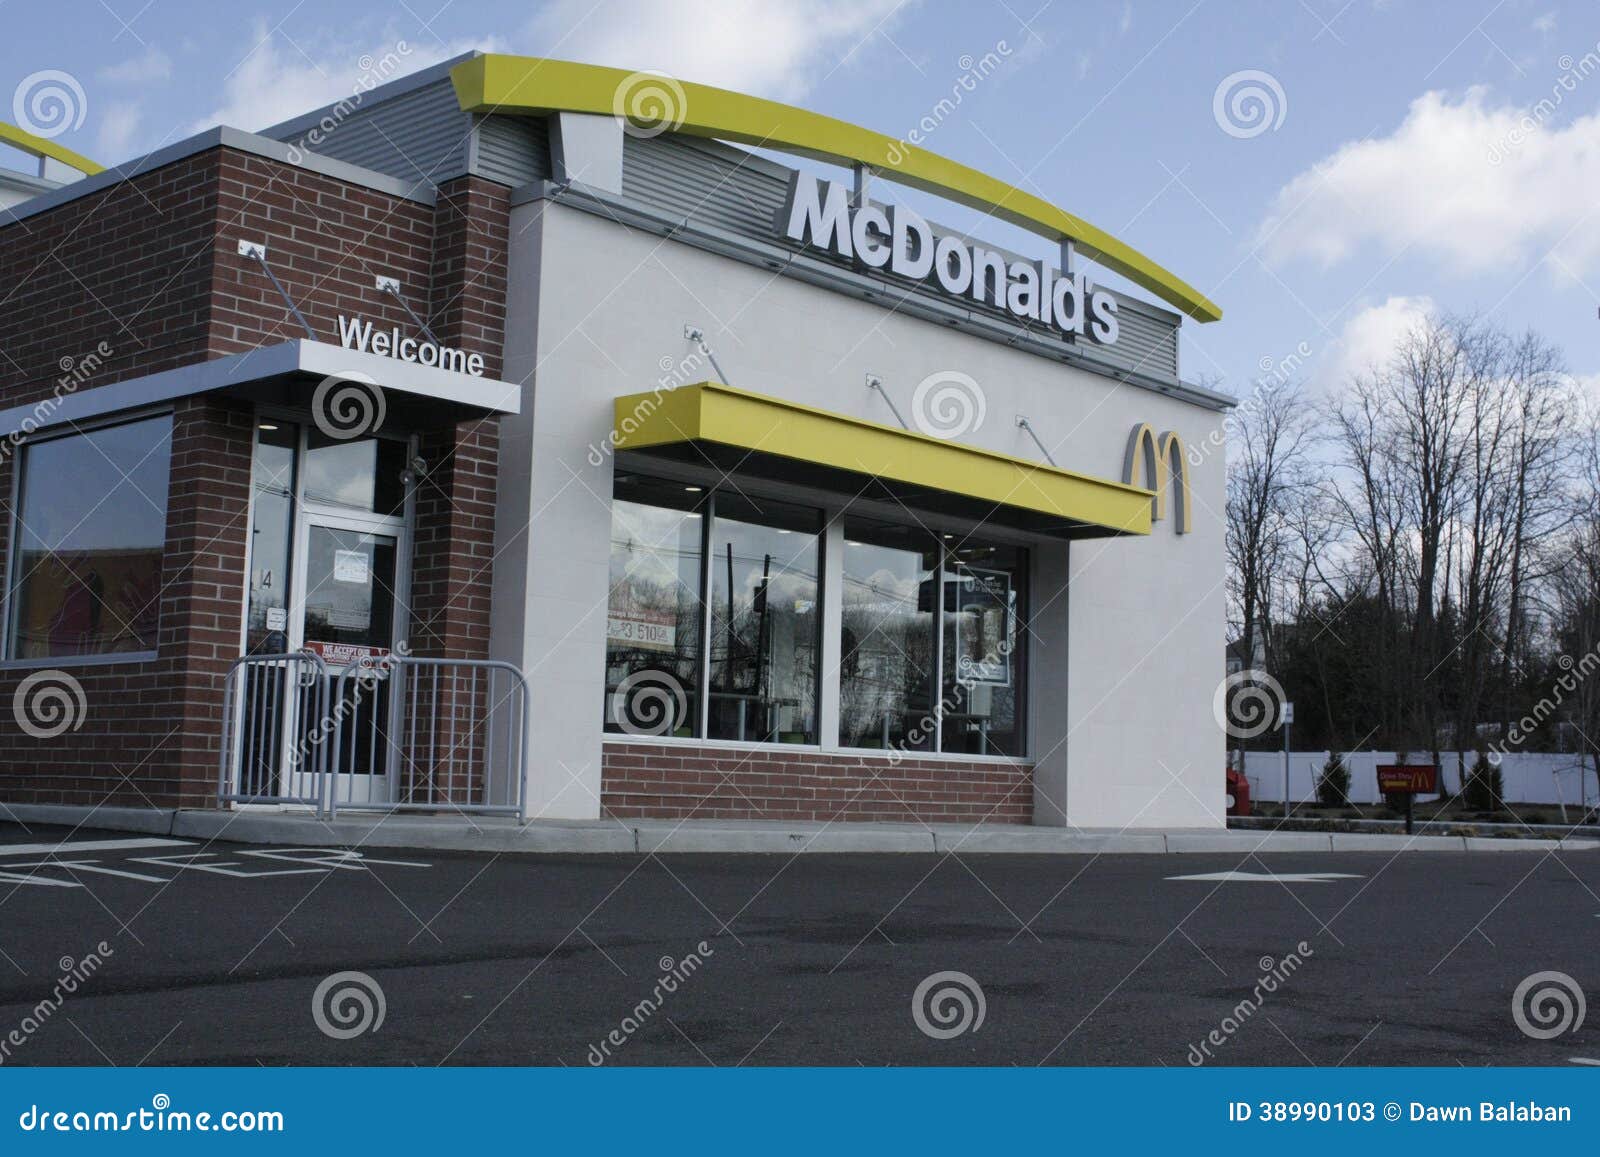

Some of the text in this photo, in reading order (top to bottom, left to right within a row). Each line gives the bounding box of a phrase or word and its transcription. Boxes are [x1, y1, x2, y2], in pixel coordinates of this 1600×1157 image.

[787, 169, 1119, 344] McDonald's
[338, 314, 484, 377] Welcome
[637, 624, 657, 640] 510
